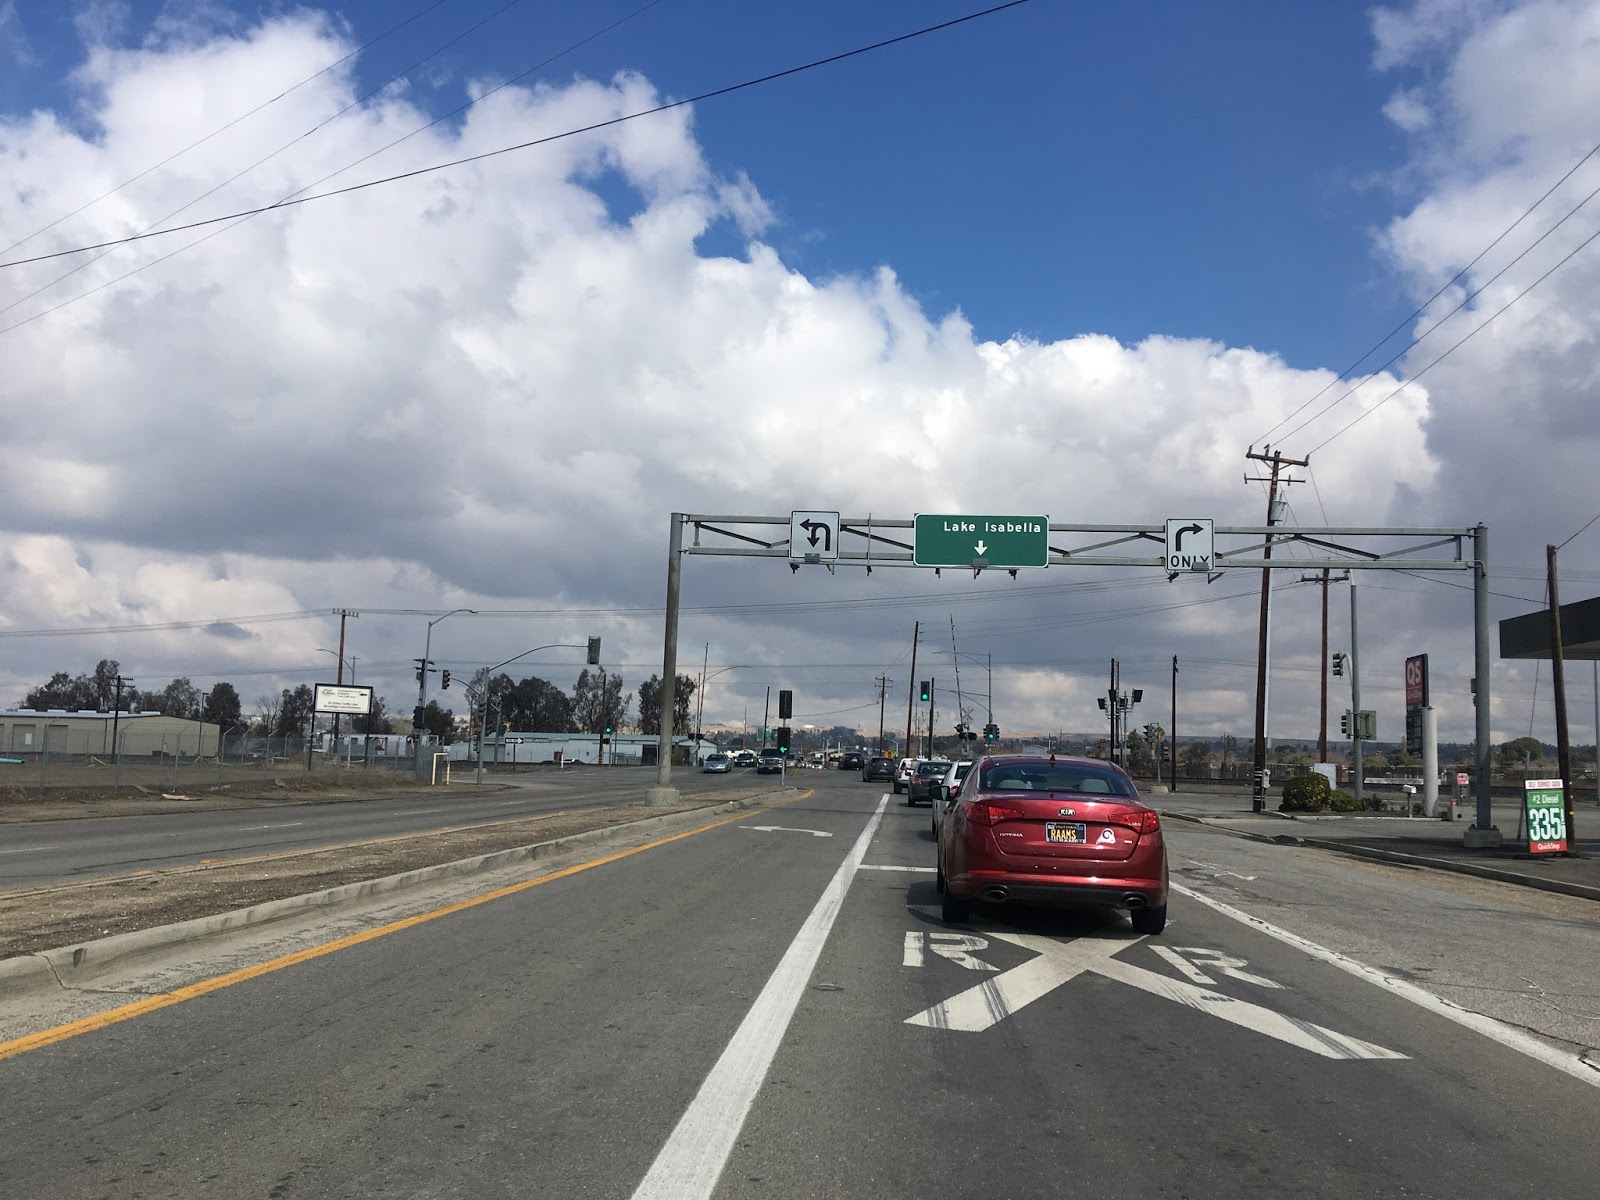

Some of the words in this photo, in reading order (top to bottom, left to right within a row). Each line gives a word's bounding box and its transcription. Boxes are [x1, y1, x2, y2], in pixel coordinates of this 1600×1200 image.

[944, 521, 976, 532] Lake
[985, 522, 1041, 533] Isabella
[1407, 660, 1421, 686] QS
[1542, 794, 1560, 804] Diesel
[1530, 808, 1562, 841] 335
[1050, 829, 1076, 840] RAAMS
[902, 931, 1000, 971] R
[1148, 944, 1292, 989] R
